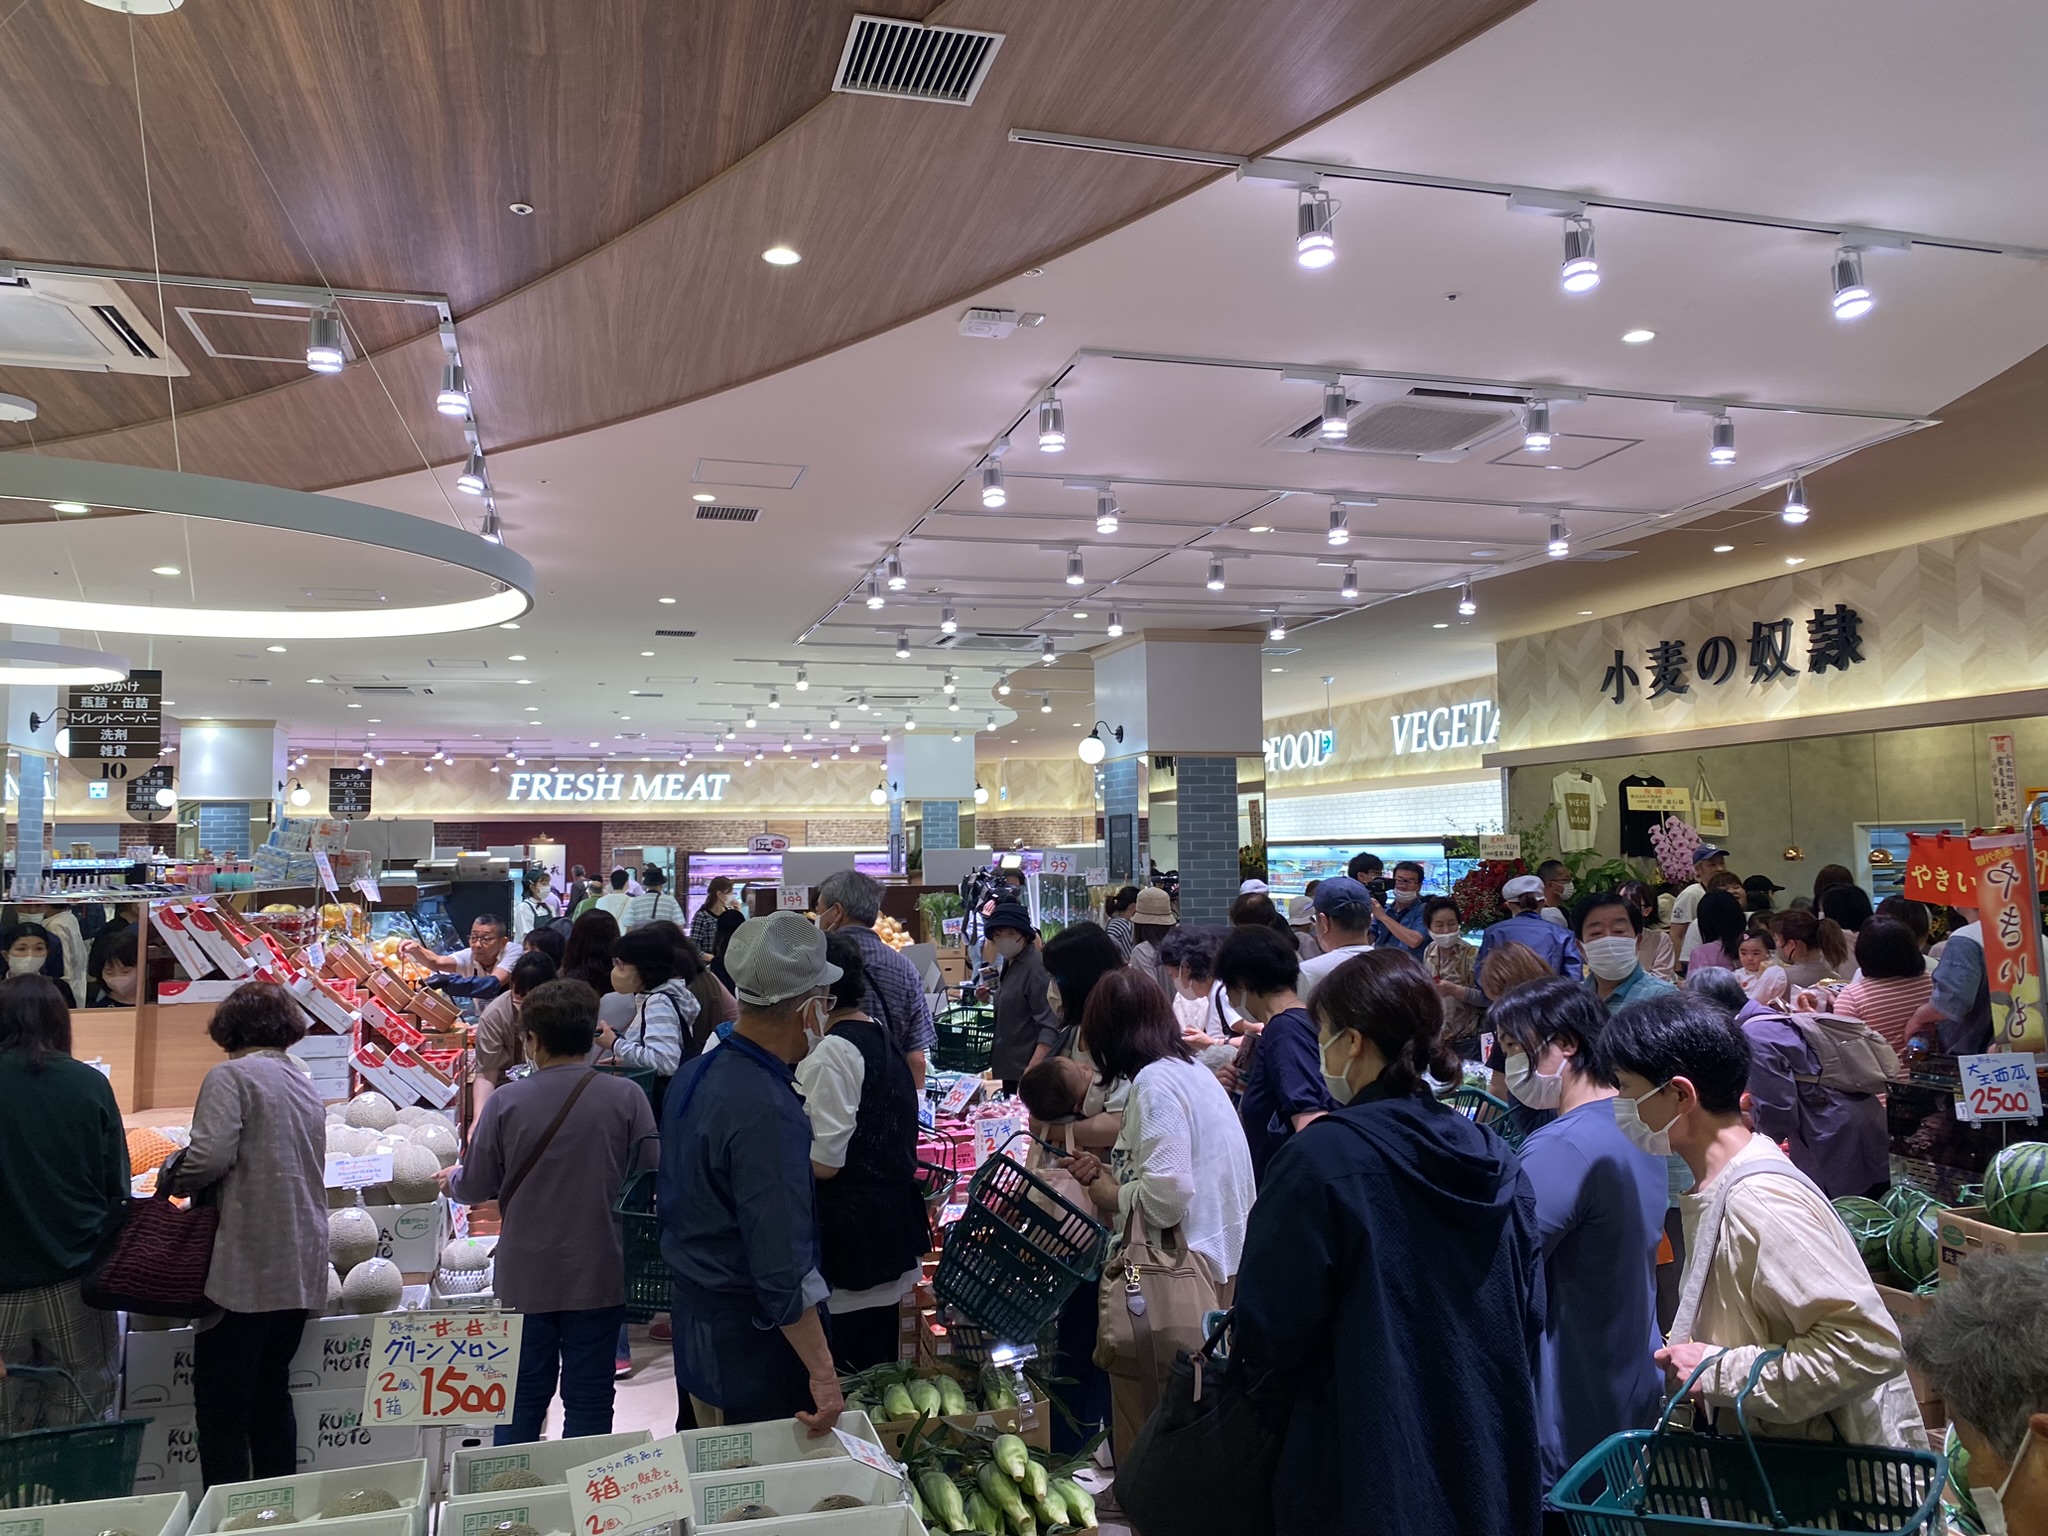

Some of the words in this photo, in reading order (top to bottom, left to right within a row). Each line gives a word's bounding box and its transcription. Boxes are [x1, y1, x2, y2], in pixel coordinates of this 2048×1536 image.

[1601, 603, 1867, 706] 小麦の奴隷
[90, 681, 141, 693] ふりかけ
[80, 696, 149, 709] 瓶詰・缶詰
[71, 712, 158, 724] トイレットペーパー
[100, 728, 128, 741] 洗剤
[100, 745, 127, 757] 雑貨
[101, 762, 127, 780] 10
[507, 772, 625, 801] FRESH
[629, 774, 731, 801] MEAT
[1050, 861, 1068, 873] 99
[783, 895, 803, 907] 199
[983, 1124, 1011, 1138] エノキ
[384, 1335, 509, 1365] グリーンメロン
[378, 1371, 417, 1392] 2個入
[373, 1396, 402, 1419] 1箱
[317, 1427, 372, 1448] MOTO
[587, 1448, 664, 1479] こちらの商品は
[585, 1467, 672, 1503] 箱での販売と
[732, 1487, 739, 1498] 7L
[585, 1515, 624, 1535] 2個入
